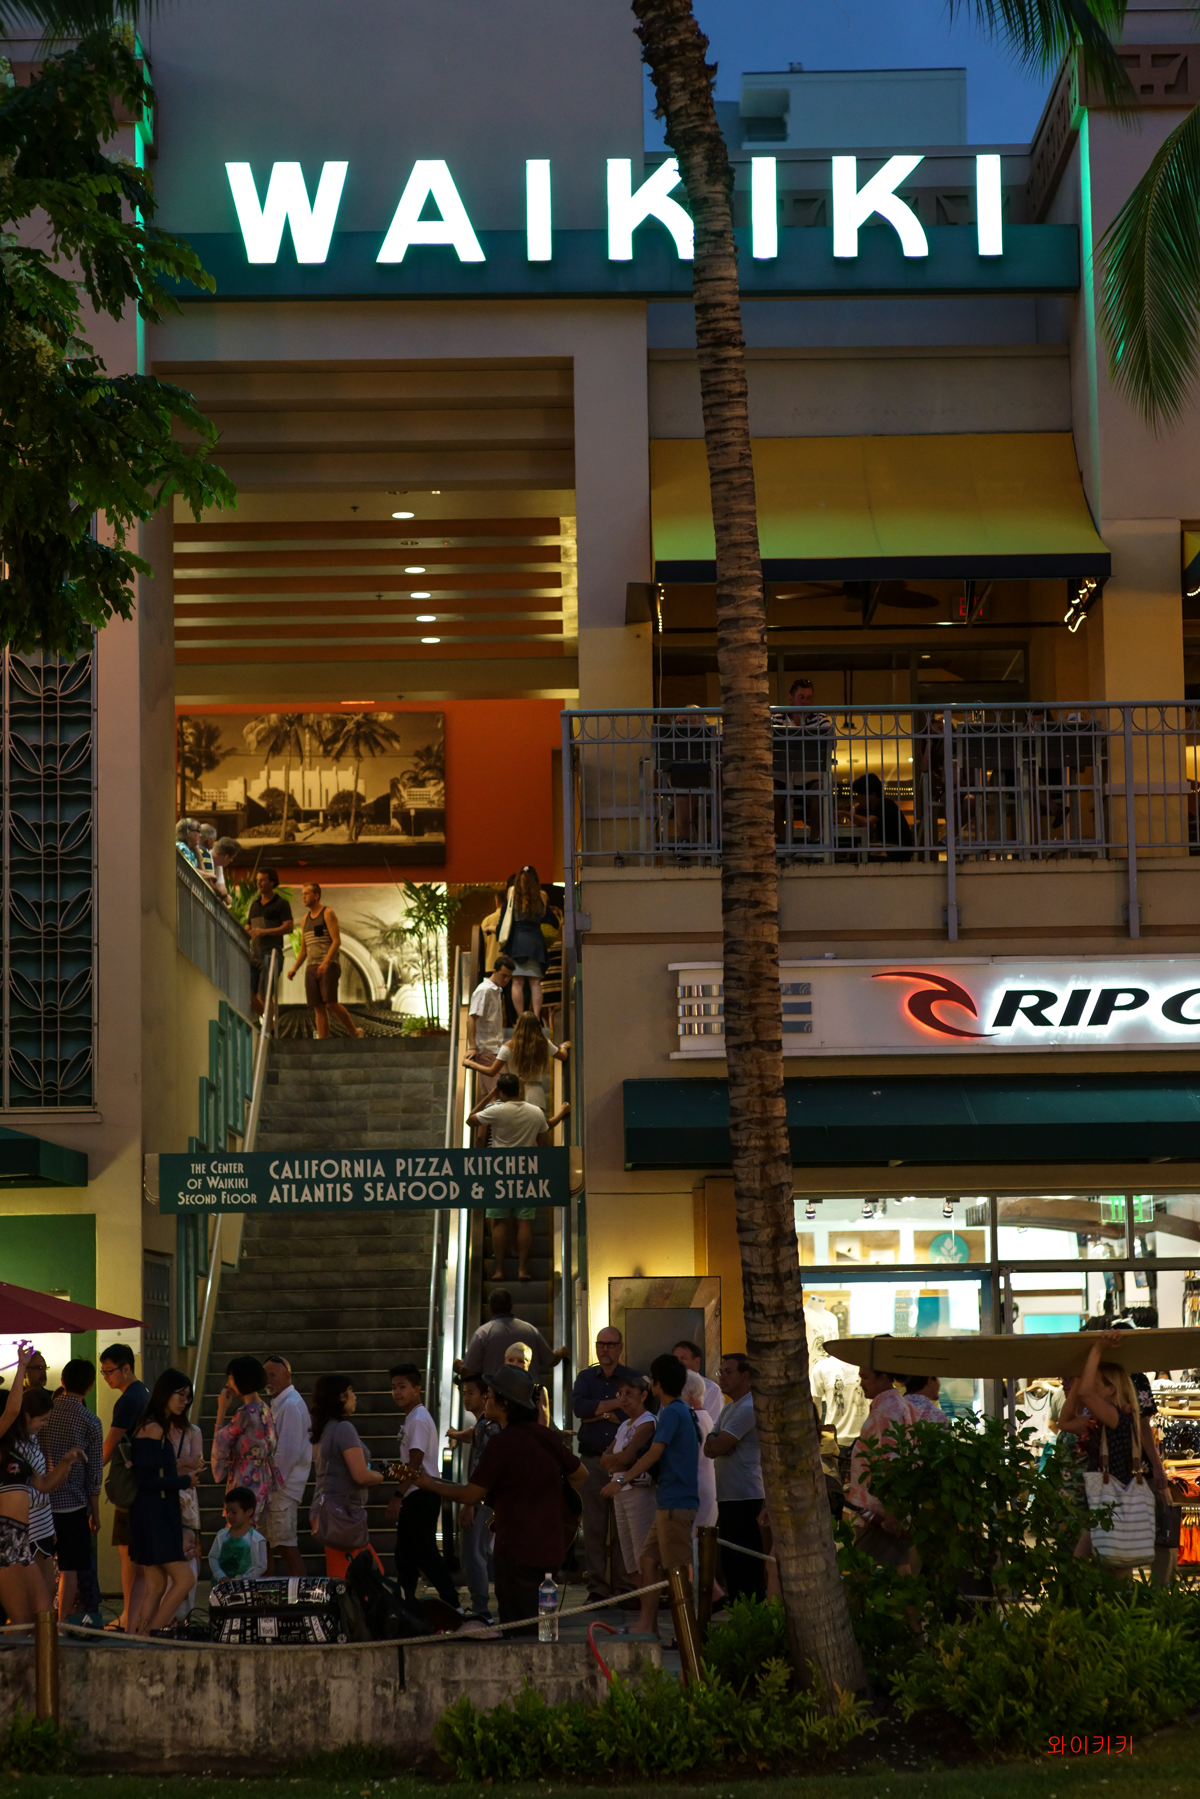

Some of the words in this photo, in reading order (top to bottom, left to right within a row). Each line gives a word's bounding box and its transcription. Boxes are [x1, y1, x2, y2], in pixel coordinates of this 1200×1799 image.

[225, 154, 1003, 264] WAIKIKI
[992, 988, 1150, 1027] RIP
[190, 1163, 206, 1174] THE
[210, 1161, 244, 1174] CENTER
[269, 1158, 386, 1180] CALIFORNIA
[396, 1157, 454, 1177] PIZZA
[464, 1155, 538, 1176] KITCHEN
[186, 1178, 203, 1190] OF
[205, 1176, 249, 1189] WAIKIKI
[268, 1182, 354, 1204] ATLANTIS
[363, 1180, 460, 1202] SEAFOOD
[470, 1182, 485, 1200] &
[495, 1179, 551, 1199] STEAK
[177, 1191, 217, 1206] SECOND
[221, 1191, 258, 1205] FLOOR
